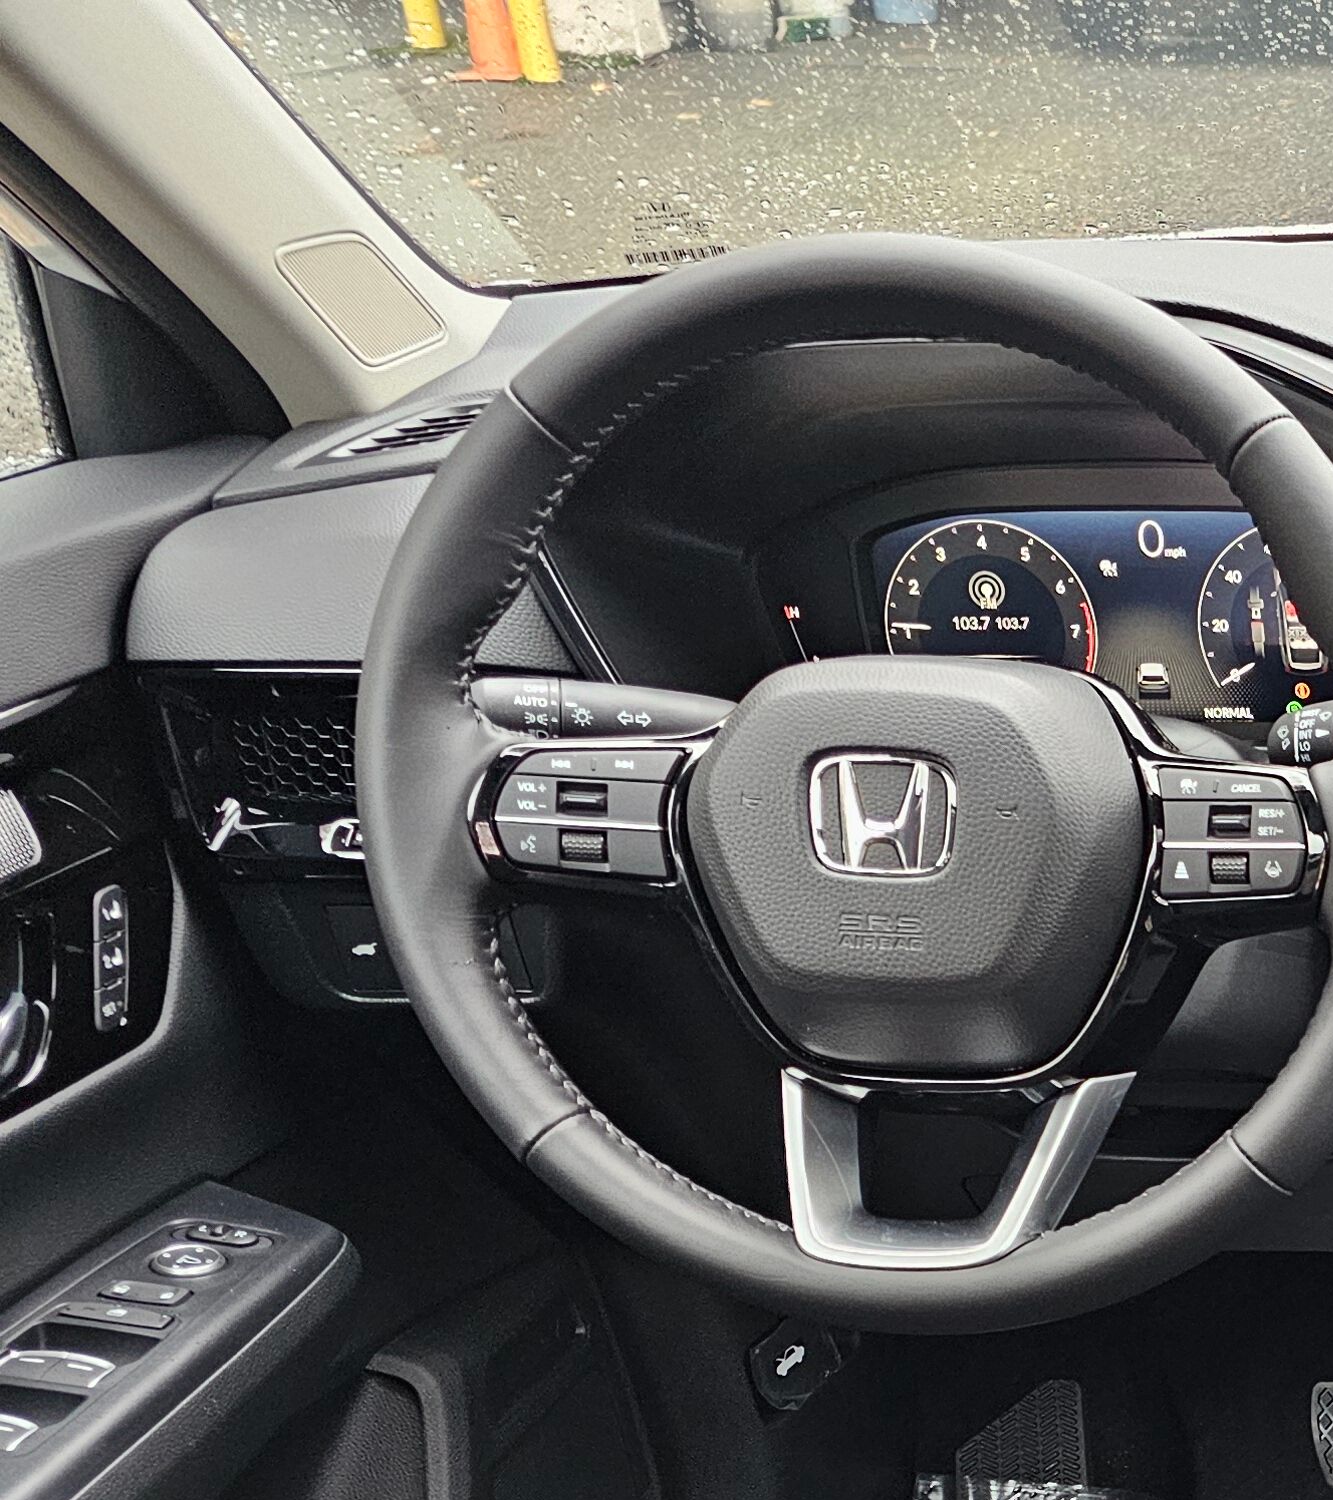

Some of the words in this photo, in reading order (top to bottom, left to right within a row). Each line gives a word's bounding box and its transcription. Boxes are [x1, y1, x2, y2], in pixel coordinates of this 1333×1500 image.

[976, 534, 988, 550] 4
[1137, 519, 1164, 558] 0
[1164, 546, 1187, 559] mph
[935, 546, 947, 562] 3
[1020, 546, 1031, 562] 5
[1224, 569, 1243, 584] 40
[908, 578, 921, 596] 2
[1055, 579, 1066, 594] 6
[979, 599, 998, 611] FM
[952, 615, 990, 631] 103.7
[994, 615, 1030, 631] 103.7
[1211, 618, 1230, 634] 20
[1070, 624, 1081, 640] 7
[513, 694, 548, 708] AUTO
[1203, 707, 1255, 720] NORMAL
[1299, 718, 1316, 730] OFF
[1298, 729, 1313, 740] INT
[1230, 783, 1262, 793] CANCEL
[839, 934, 924, 951] AIRBAG
